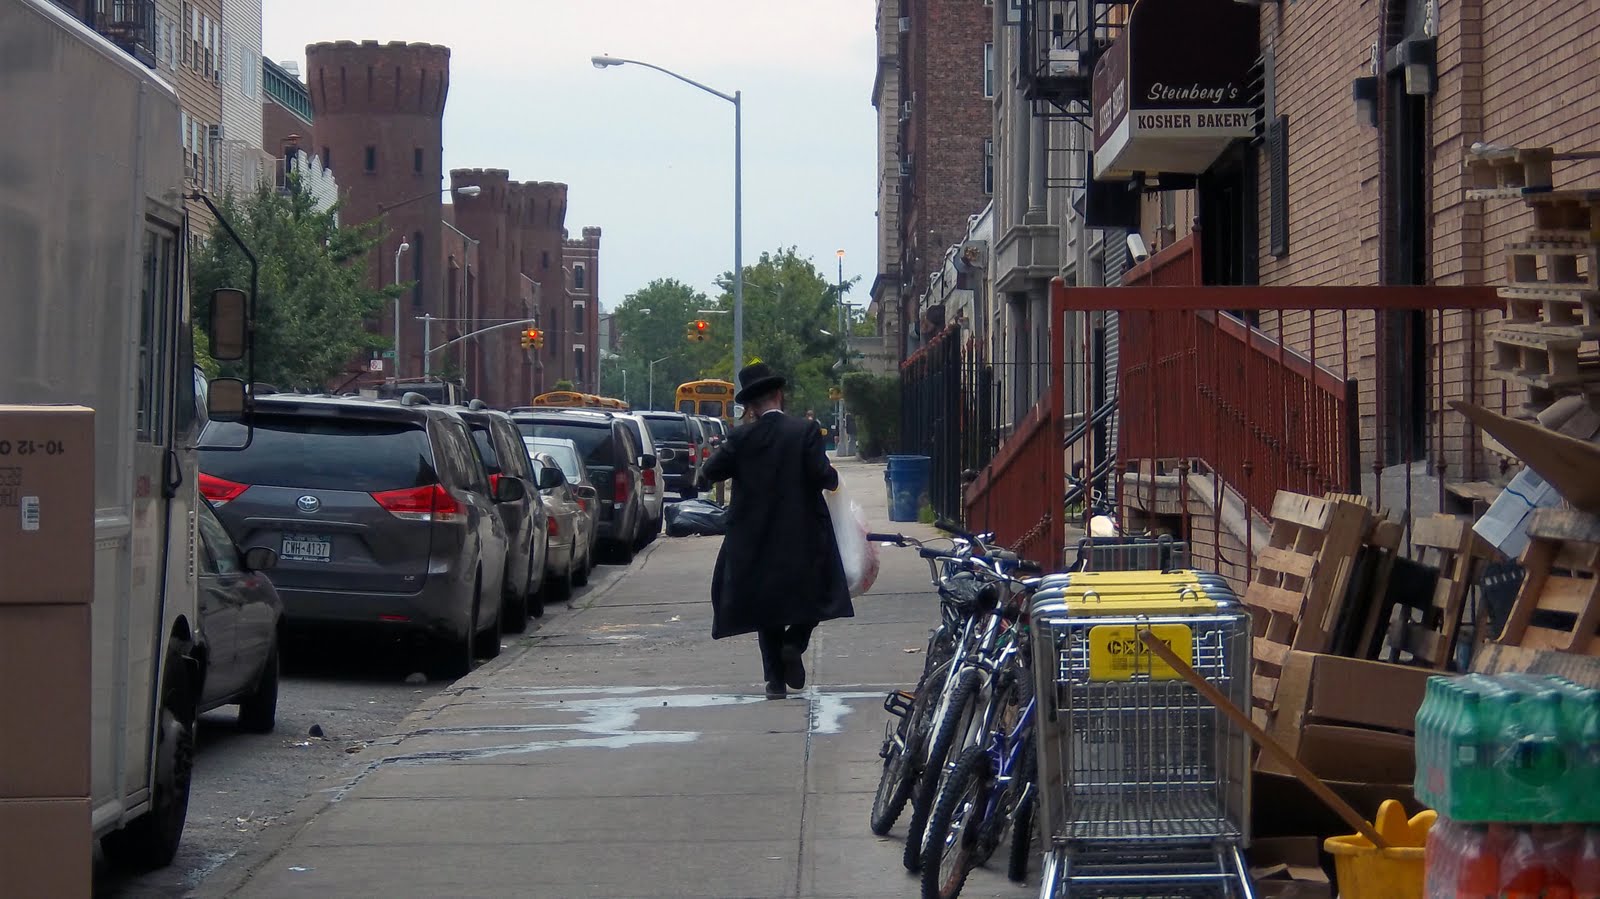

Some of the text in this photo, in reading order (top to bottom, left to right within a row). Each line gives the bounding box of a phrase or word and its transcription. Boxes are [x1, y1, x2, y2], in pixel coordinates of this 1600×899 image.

[1147, 82, 1238, 104] Steinberg's
[1138, 113, 1249, 129] KOSHER BAKERY
[17, 440, 65, 455] 10-12
